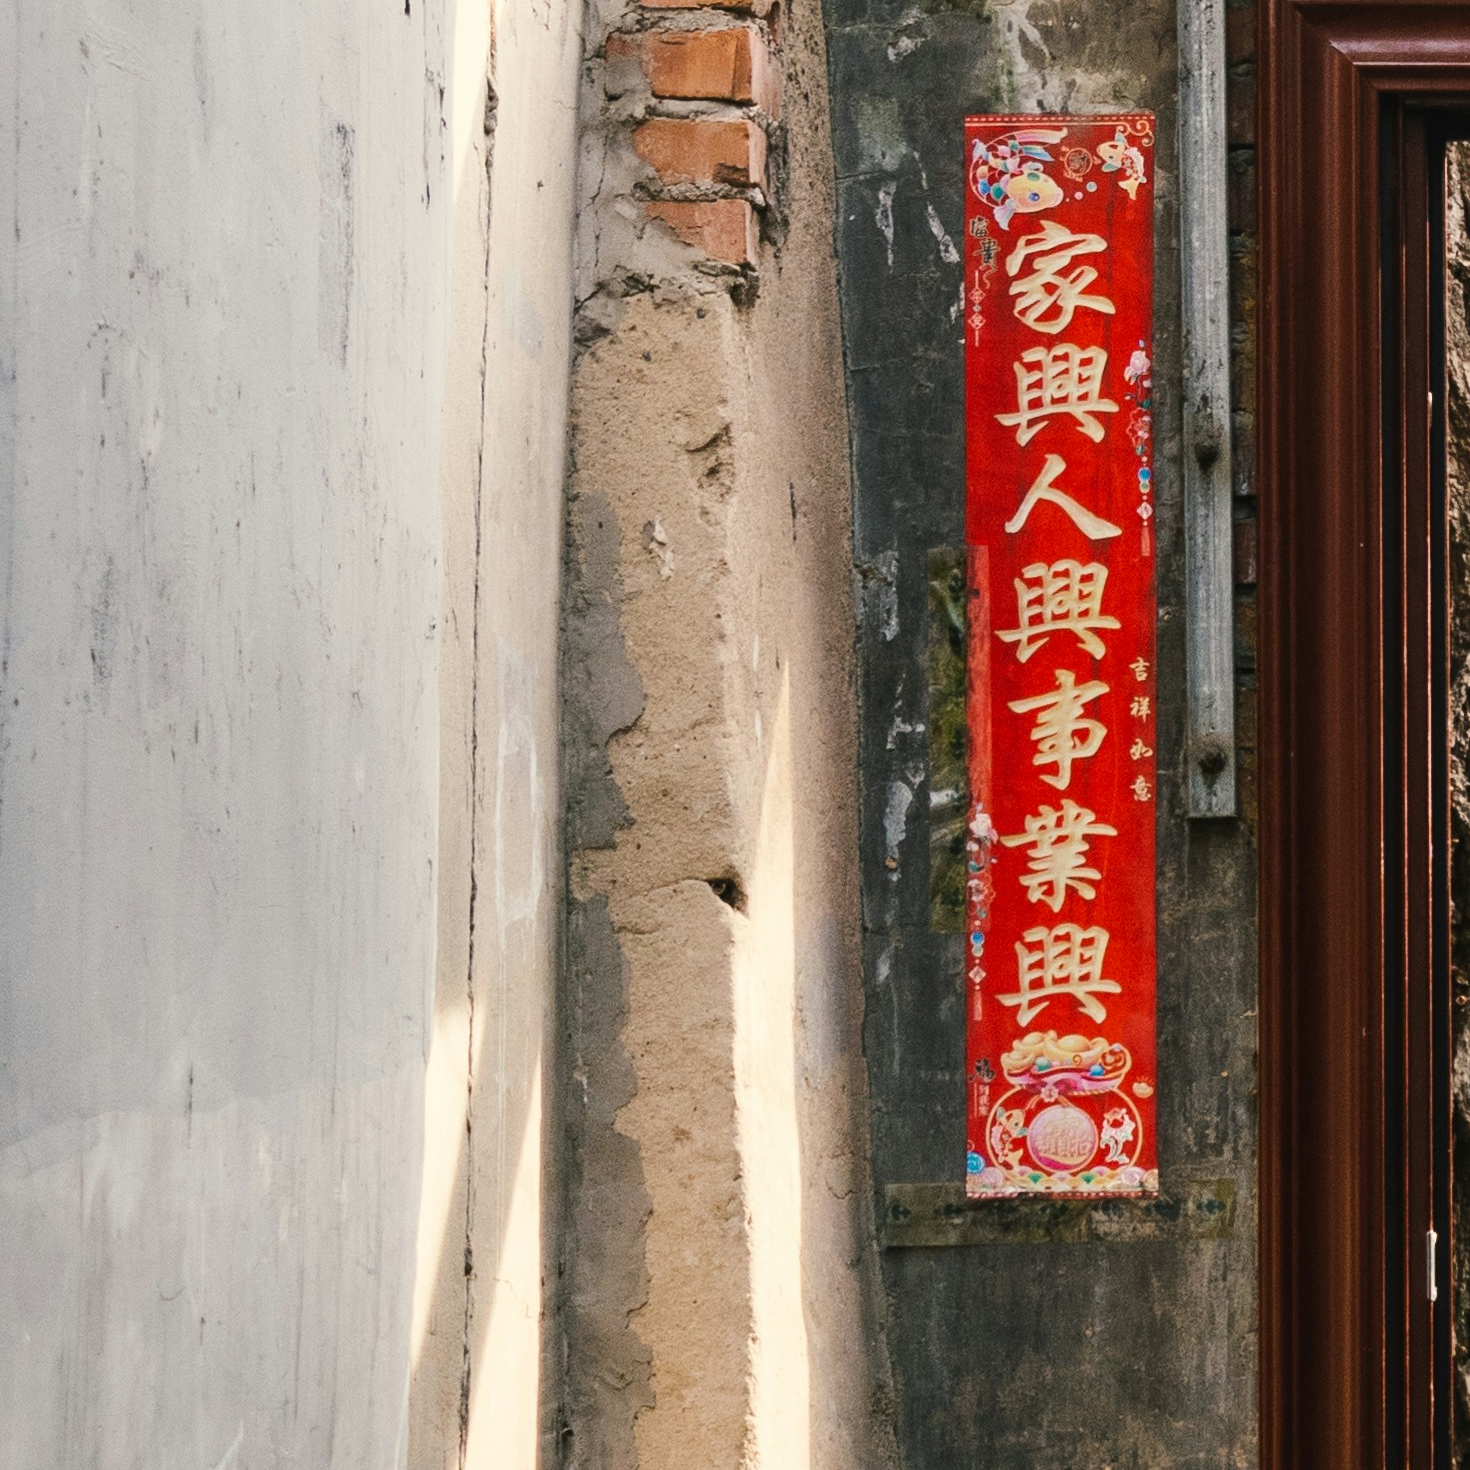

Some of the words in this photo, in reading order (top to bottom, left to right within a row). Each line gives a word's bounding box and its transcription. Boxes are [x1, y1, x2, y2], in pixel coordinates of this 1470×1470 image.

[994, 219, 1124, 1028] 家興人興事業興
[1128, 656, 1154, 802] 吉祥如意
